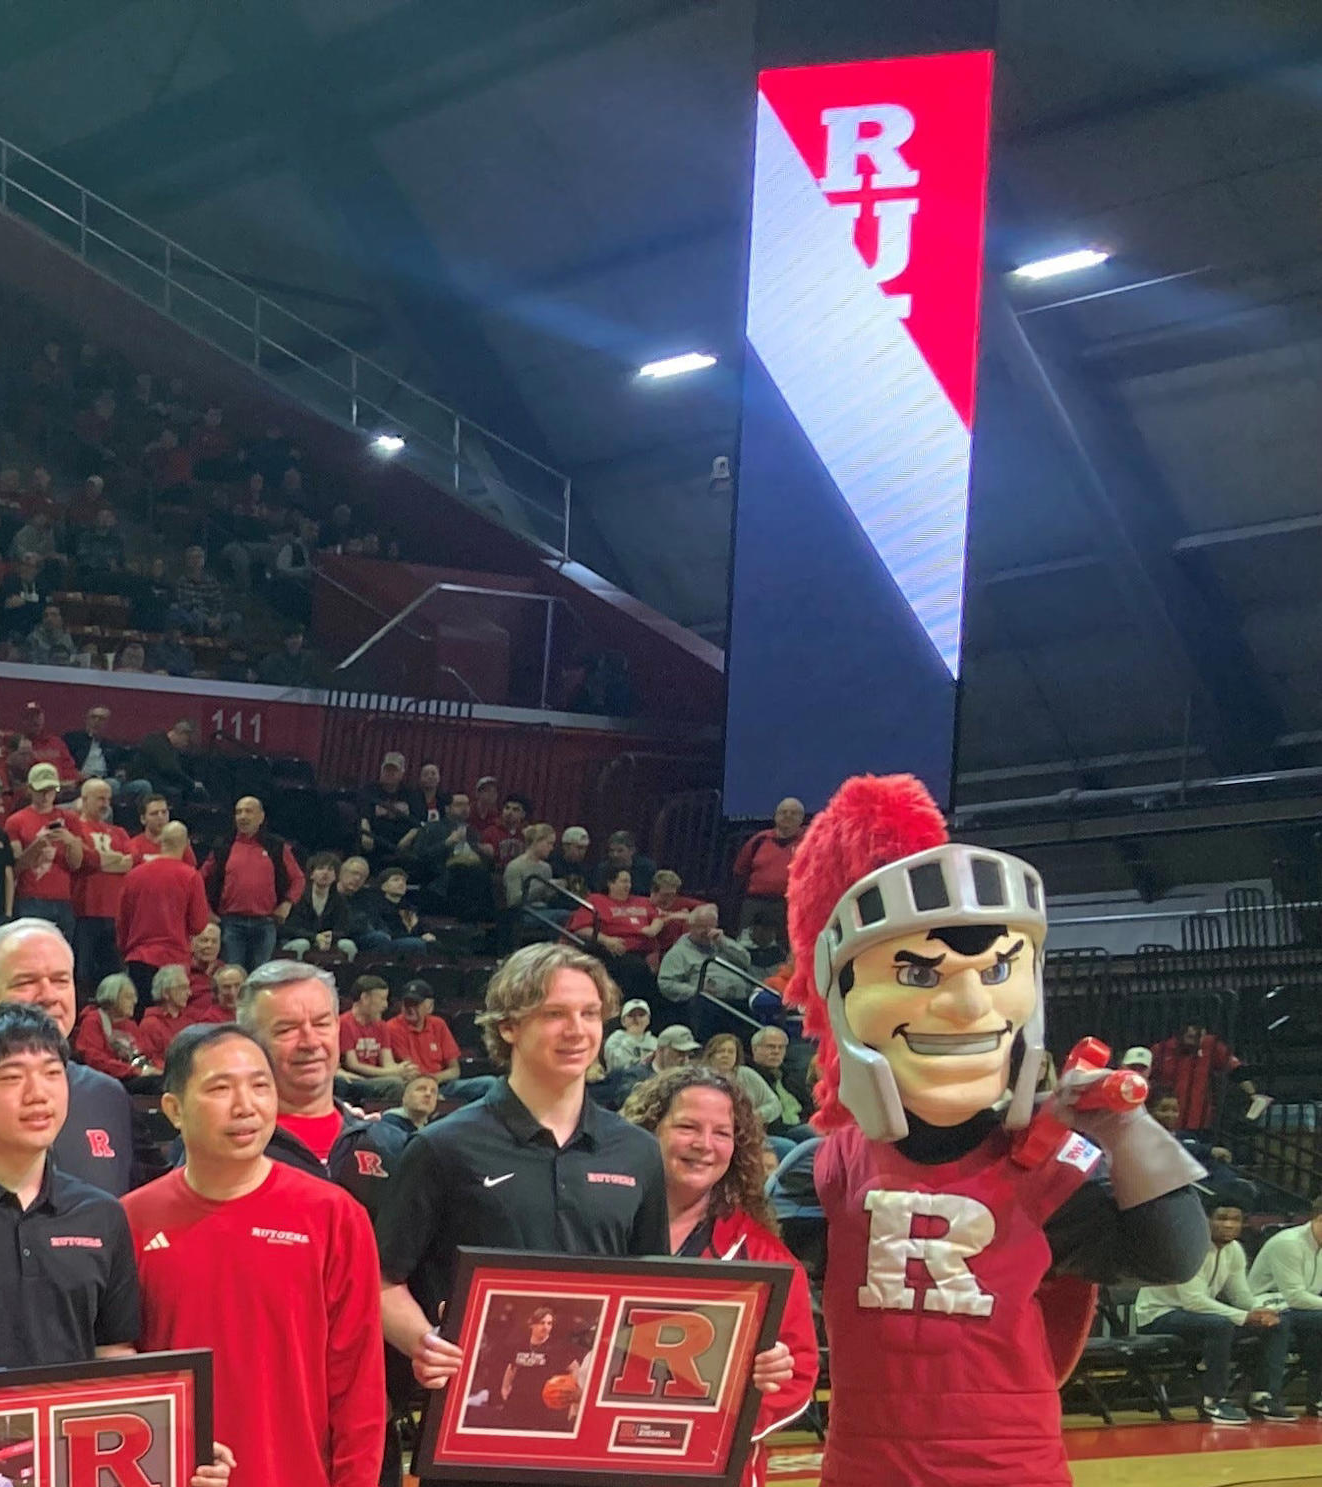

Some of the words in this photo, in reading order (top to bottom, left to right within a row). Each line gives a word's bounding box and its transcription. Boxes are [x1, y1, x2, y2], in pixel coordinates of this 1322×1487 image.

[211, 708, 262, 742] 111
[85, 1129, 115, 1158] R
[356, 1150, 389, 1177] R
[587, 1171, 636, 1188] RUTGERS
[50, 1236, 103, 1248] RUTGERS
[251, 1226, 310, 1244] RUTGERS
[858, 1189, 997, 1318] R
[612, 1308, 716, 1398] R
